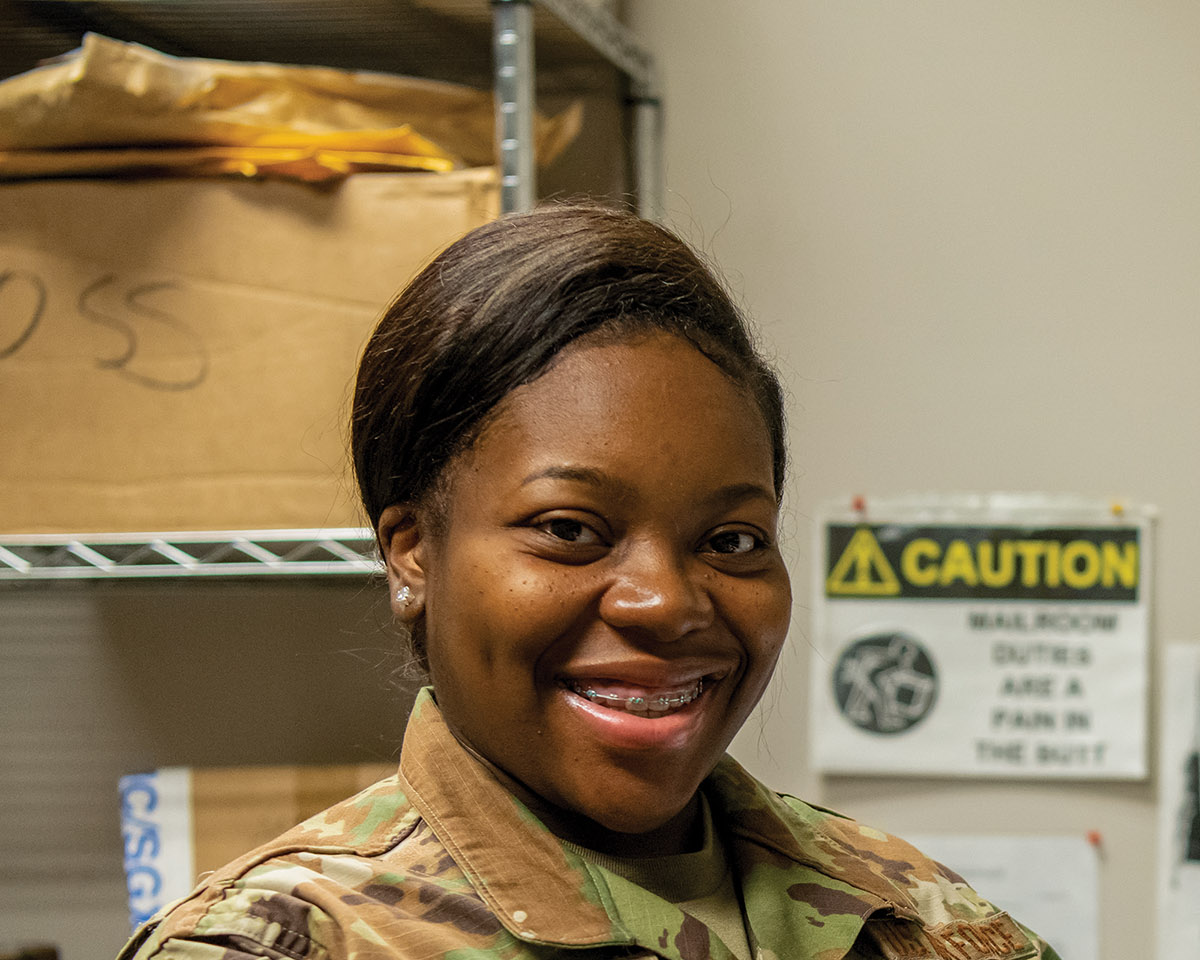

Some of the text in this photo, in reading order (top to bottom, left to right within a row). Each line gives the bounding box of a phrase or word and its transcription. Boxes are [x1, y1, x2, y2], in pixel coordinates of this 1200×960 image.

[902, 538, 1139, 588] CAUTION
[968, 612, 1118, 632] MAILROOM
[992, 644, 1092, 666] DUTIES
[1003, 677, 1083, 697] ARE A
[991, 711, 1090, 731] PAIN IN
[975, 743, 1106, 764] THE BUTT
